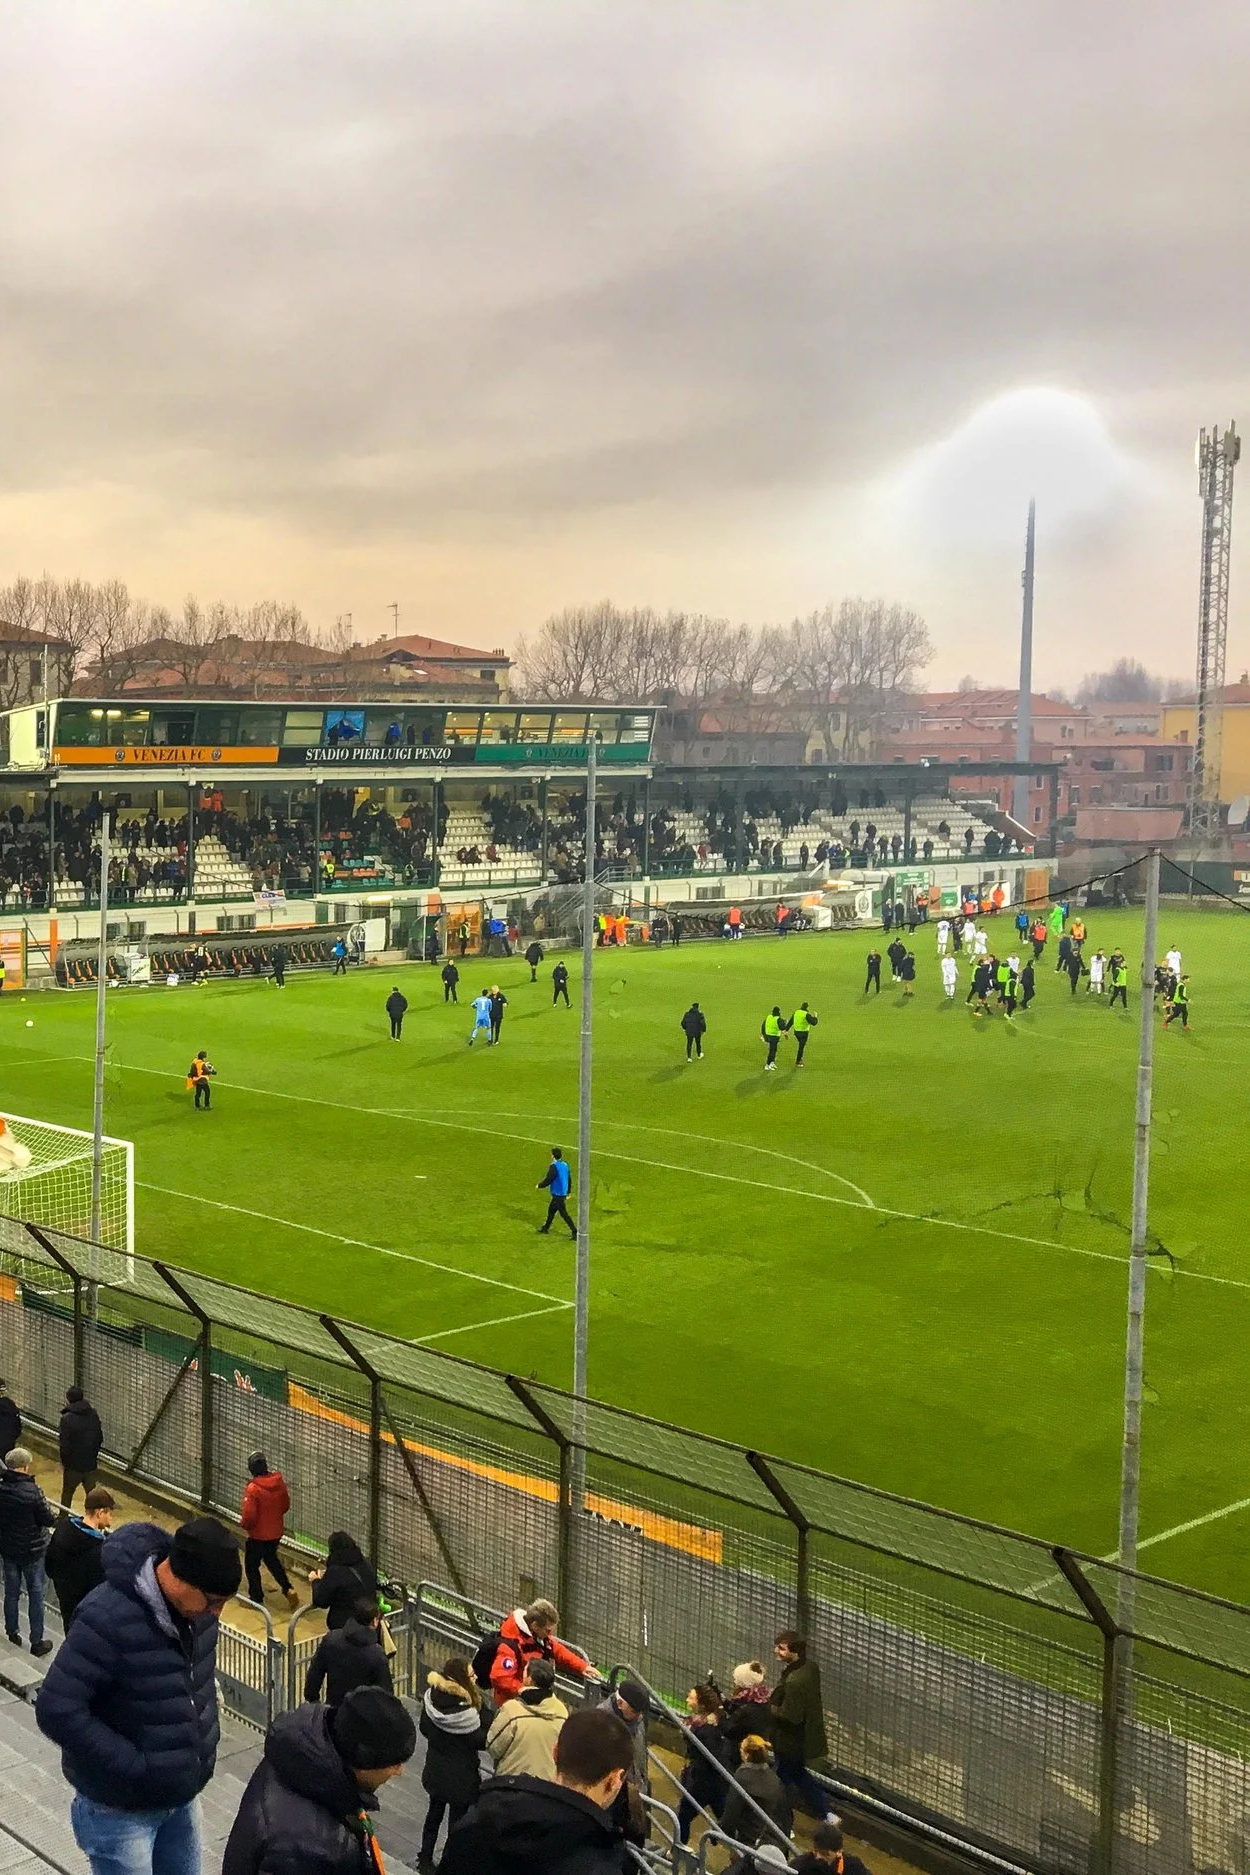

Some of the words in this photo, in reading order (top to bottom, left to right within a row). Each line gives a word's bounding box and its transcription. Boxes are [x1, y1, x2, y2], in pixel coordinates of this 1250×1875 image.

[133, 748, 186, 761] VENEZIA
[191, 748, 206, 761] FC
[305, 748, 349, 761] STADIO
[351, 748, 412, 760] PIERLUIGI
[414, 747, 451, 760] PENZO
